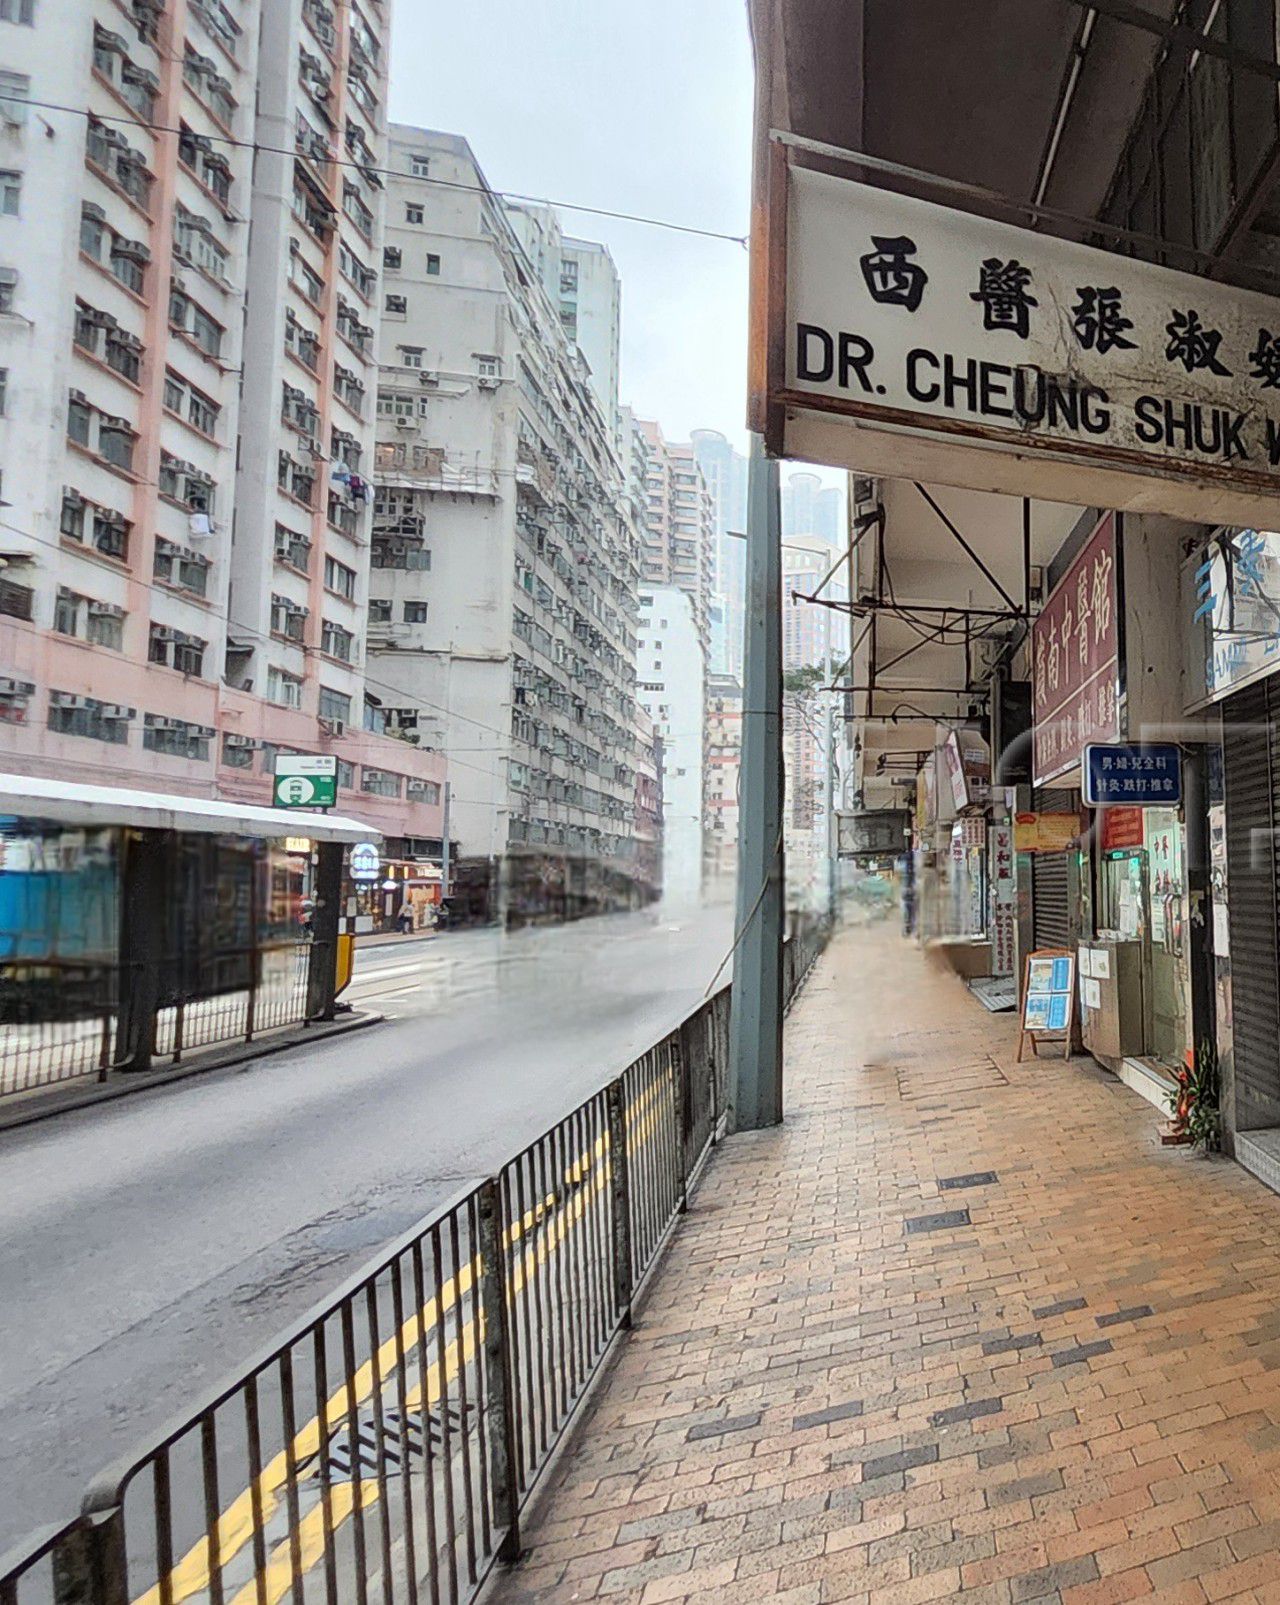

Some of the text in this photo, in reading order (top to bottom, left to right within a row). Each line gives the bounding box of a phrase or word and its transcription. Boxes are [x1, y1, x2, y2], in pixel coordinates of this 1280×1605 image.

[797, 323, 886, 395] DR.
[906, 347, 1111, 434] CHEUNG
[1134, 395, 1247, 461] SHUK
